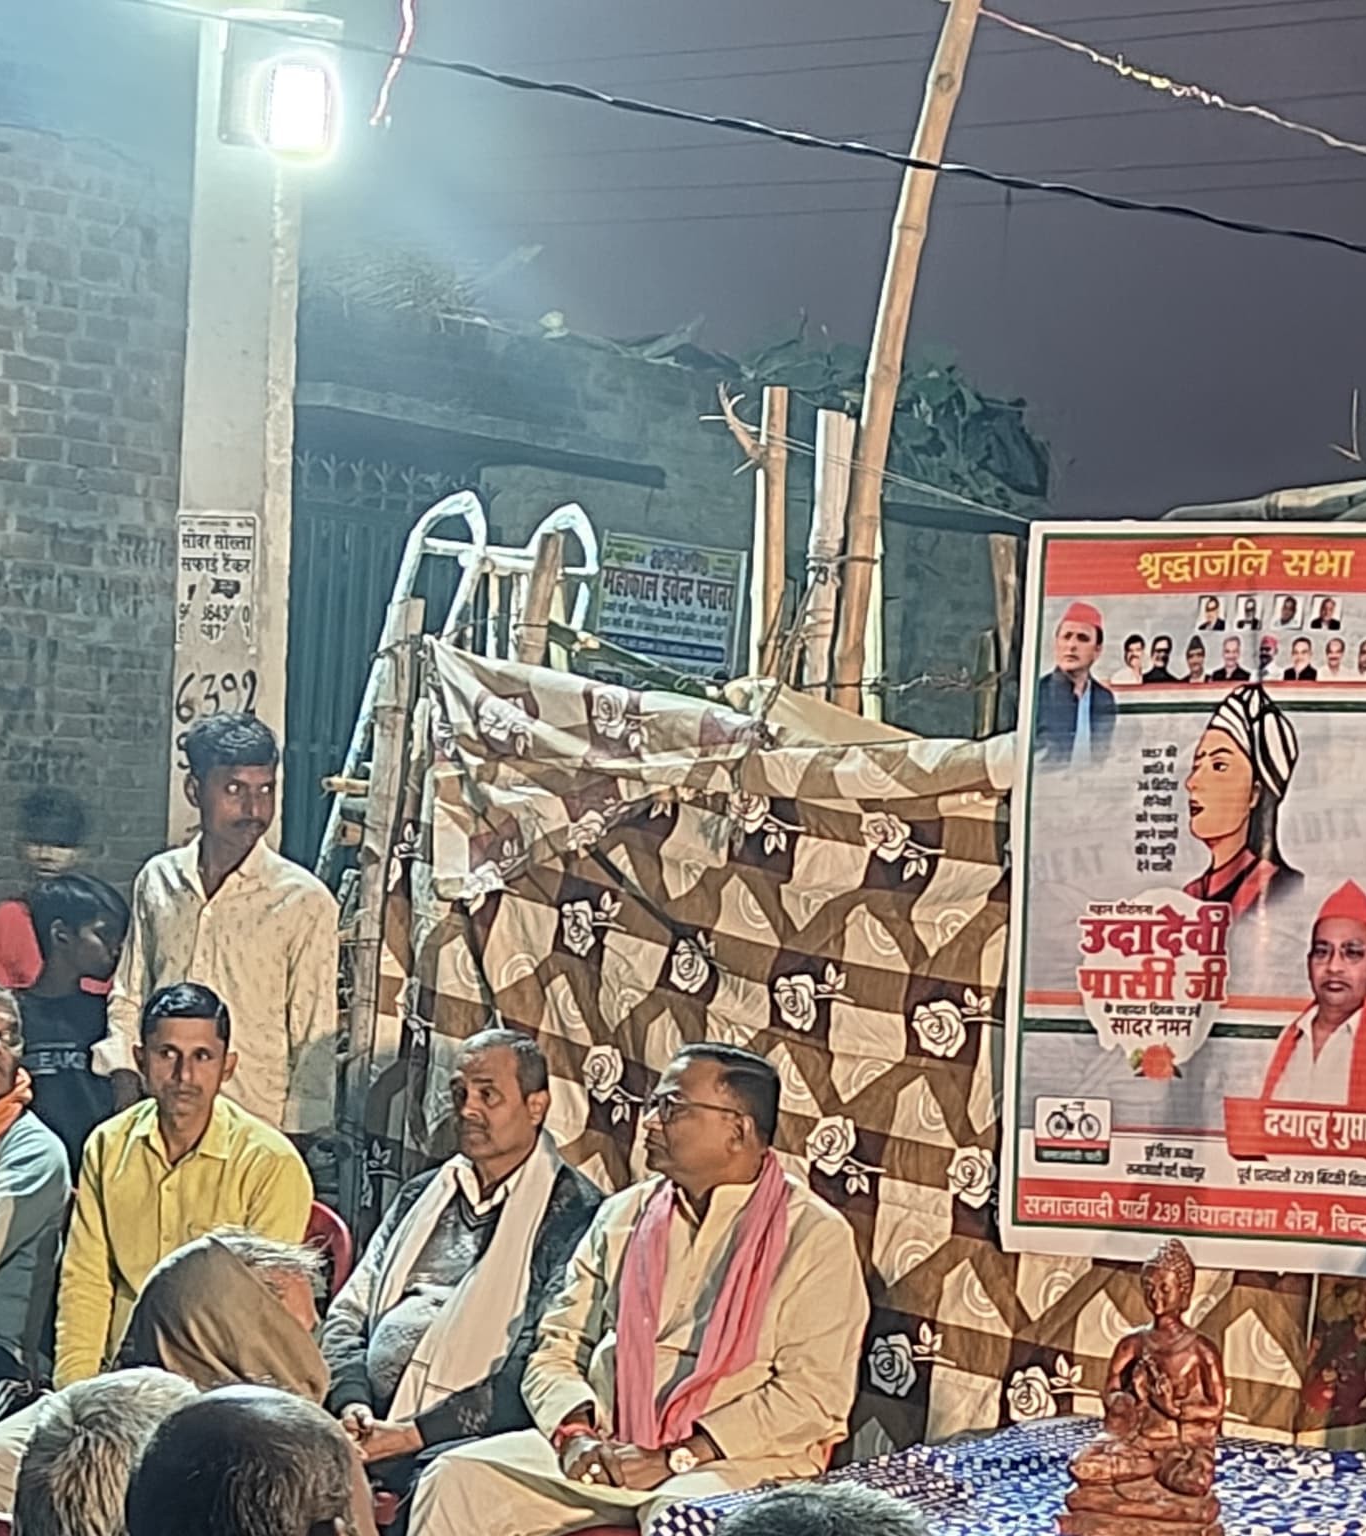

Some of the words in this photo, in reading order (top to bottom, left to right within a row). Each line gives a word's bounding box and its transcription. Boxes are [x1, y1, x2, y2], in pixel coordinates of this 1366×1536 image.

[1282, 549, 1355, 578] सभा
[1078, 903, 1231, 957] उदादेवी
[1078, 957, 1176, 1000] पासी
[1184, 957, 1228, 1001] जी
[1109, 1017, 1154, 1037] सादर
[1155, 1017, 1193, 1037] नमन
[1263, 1107, 1331, 1149] दयालु
[1293, 1170, 1314, 1185] 239
[1023, 1191, 1114, 1219] समाजवादी
[1117, 1192, 1152, 1221] पार्टी
[1152, 1201, 1181, 1223] 239
[1184, 1196, 1279, 1229] विधानसभा
